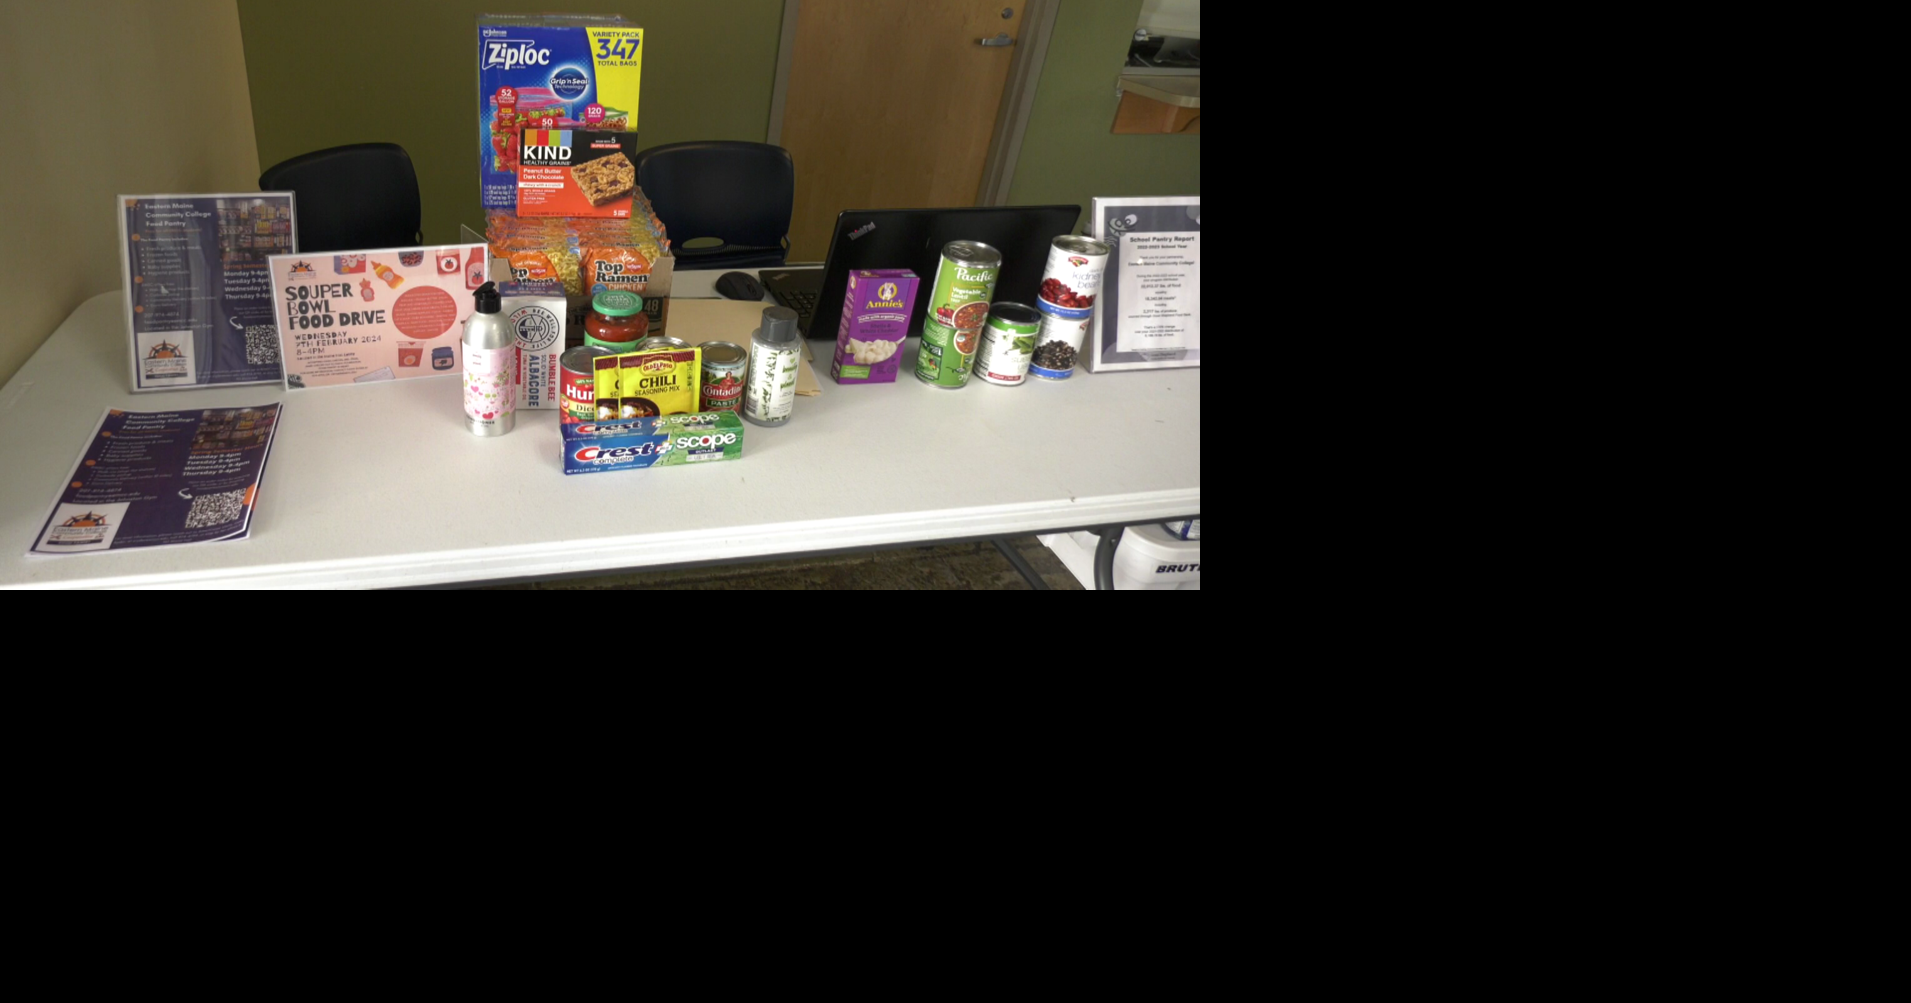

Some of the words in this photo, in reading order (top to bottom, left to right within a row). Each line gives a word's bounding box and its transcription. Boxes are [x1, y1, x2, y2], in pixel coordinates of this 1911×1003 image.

[596, 38, 640, 60] 347
[488, 43, 550, 70] Ziploc
[524, 146, 572, 160] KIND
[595, 261, 623, 275] Top
[955, 267, 993, 282] Pacific
[596, 272, 648, 282] Ramen
[285, 283, 353, 301] SOUPER
[952, 287, 981, 295] Vegetable
[287, 299, 336, 316] BOWL
[644, 299, 659, 312] 48
[866, 299, 904, 309] Annie's
[289, 314, 334, 330] FOOD
[339, 310, 386, 326] DRIVE
[295, 331, 347, 340] WEDNESDAY
[316, 338, 358, 347] FEBRUARY
[361, 335, 382, 343] 2024
[549, 354, 557, 385] BUMBLE
[528, 354, 540, 407] ALBACORE
[639, 375, 676, 389] CHILI
[634, 386, 668, 396] SEASONING
[576, 421, 642, 434] Crest
[670, 414, 719, 424] scope
[575, 442, 654, 462] Crest
[676, 433, 737, 449] scope
